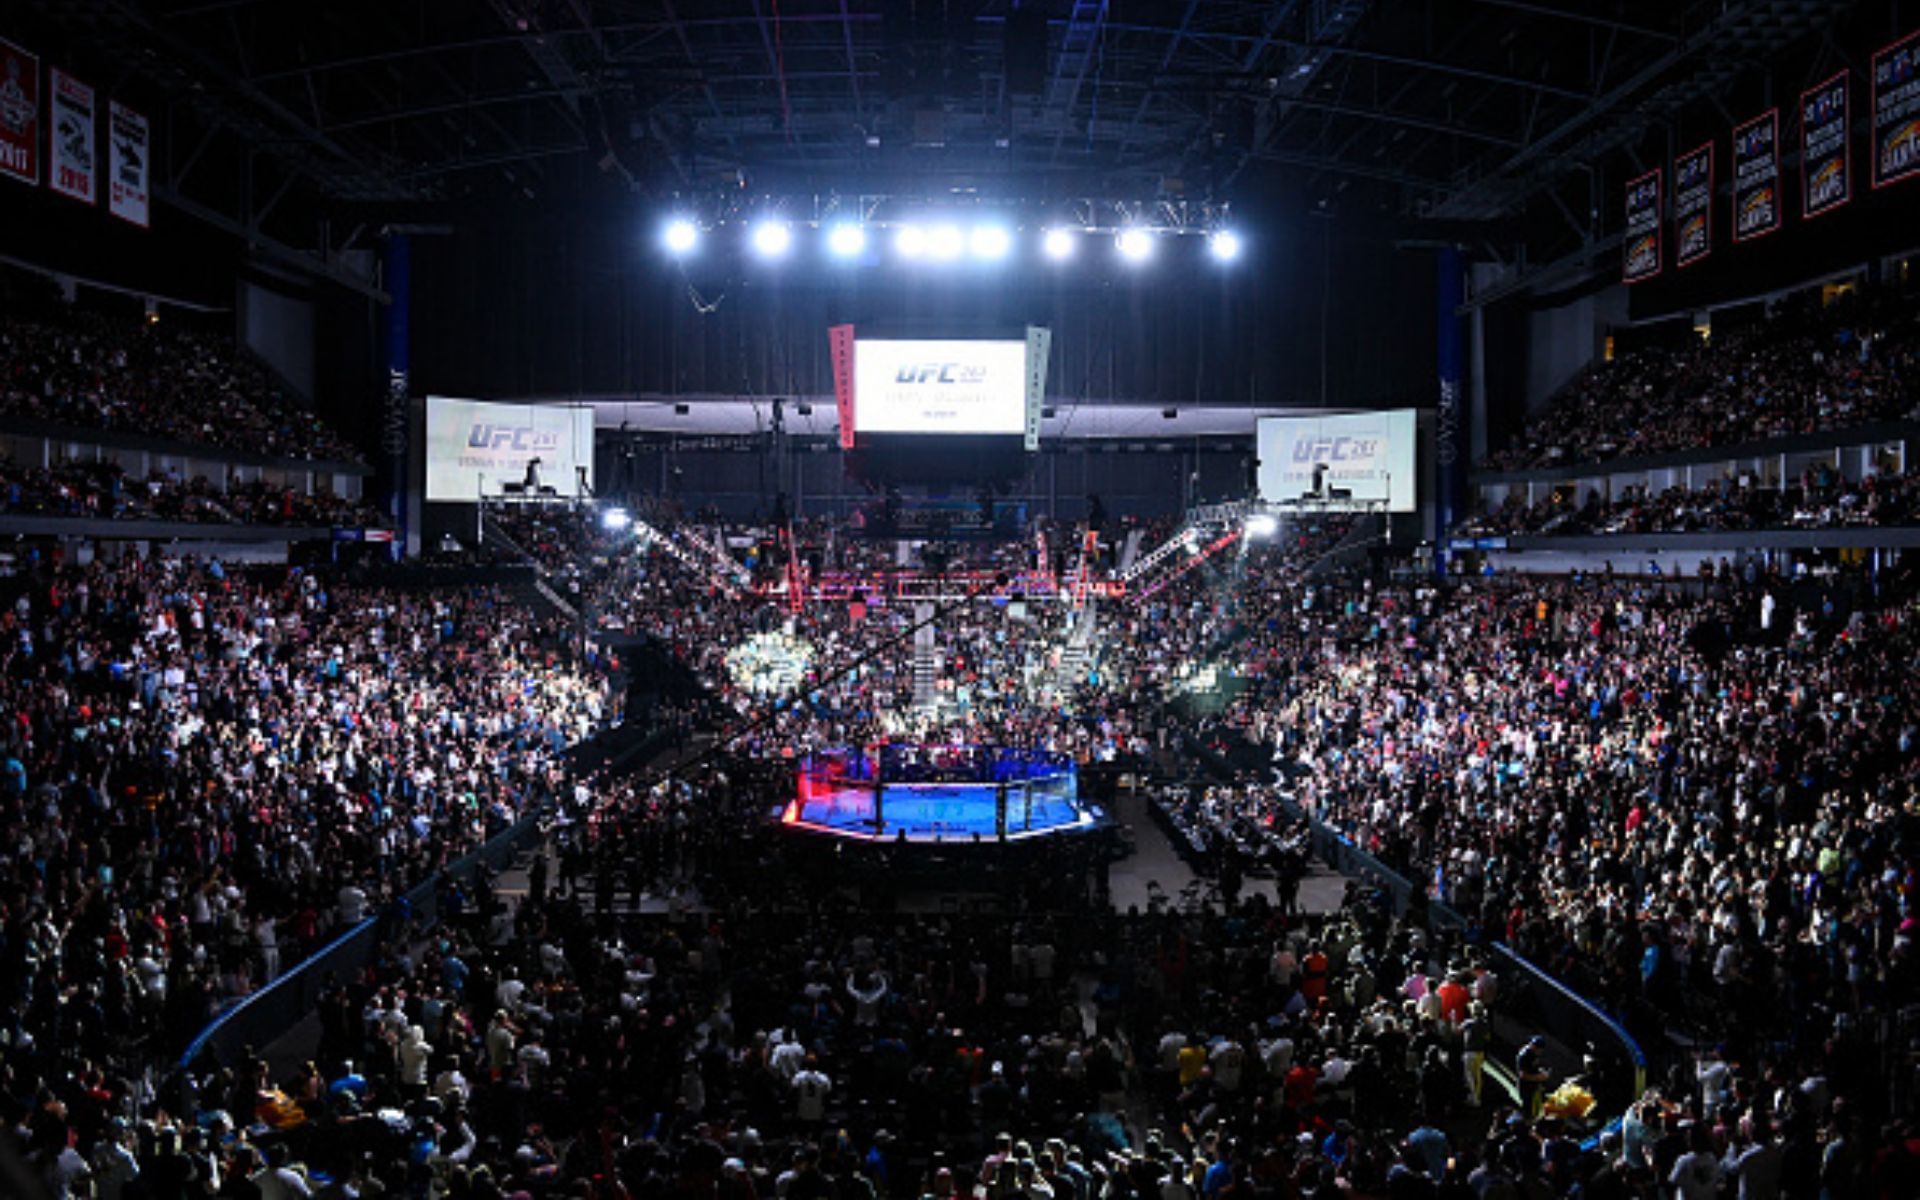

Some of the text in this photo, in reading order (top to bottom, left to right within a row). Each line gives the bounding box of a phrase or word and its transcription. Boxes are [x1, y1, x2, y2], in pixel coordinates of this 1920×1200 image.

[894, 362, 960, 384] UFC
[468, 423, 532, 451] UFC
[1293, 437, 1351, 463] UFC
